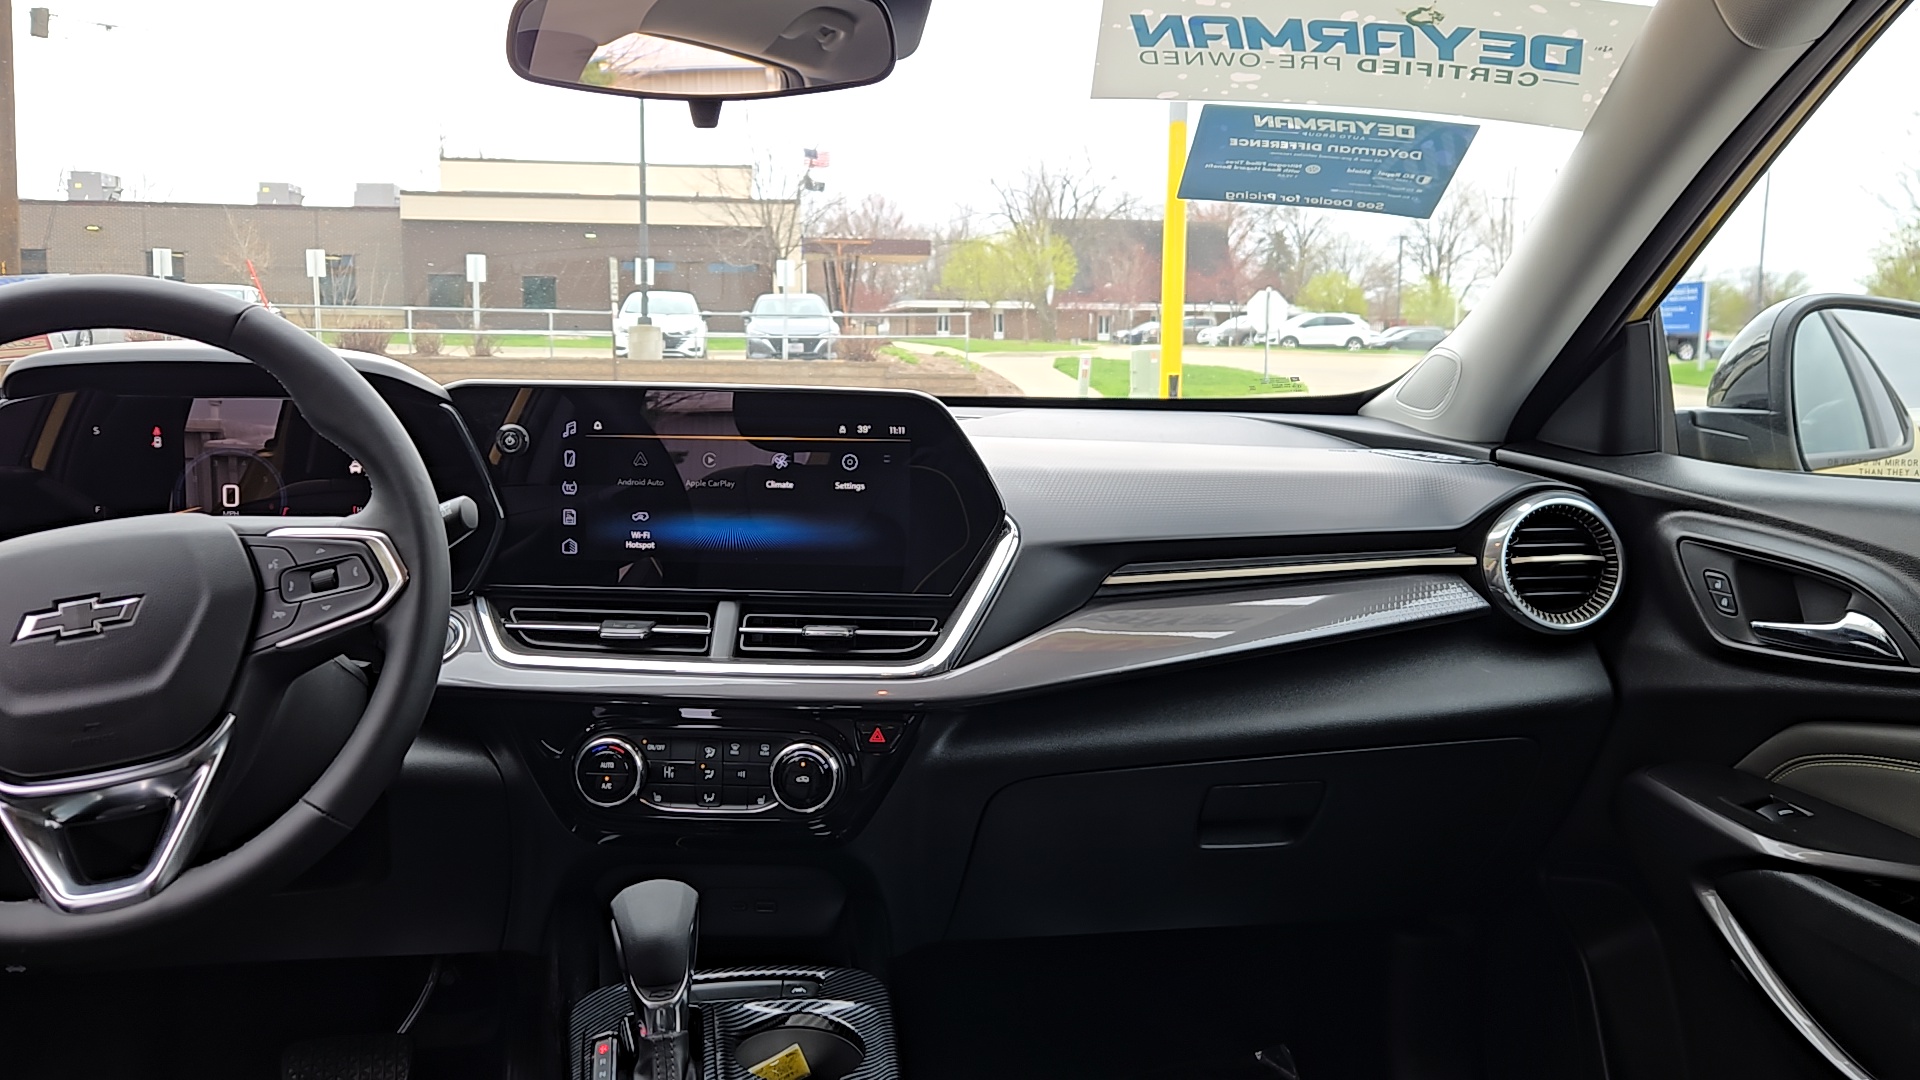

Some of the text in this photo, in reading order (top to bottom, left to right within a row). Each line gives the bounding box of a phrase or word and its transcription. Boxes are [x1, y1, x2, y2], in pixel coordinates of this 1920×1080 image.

[889, 426, 906, 435] 11:11
[1884, 459, 1919, 467] MIRROR
[1887, 468, 1910, 476] THEY
[617, 478, 665, 487] Android Auto
[685, 479, 736, 489] Apple CarPlay
[765, 480, 795, 489] Climate
[834, 481, 866, 491] Settings
[222, 484, 240, 508] 0
[630, 531, 651, 539] Wi-Fi
[625, 540, 656, 550] Hotspot
[600, 761, 615, 769] AUTO
